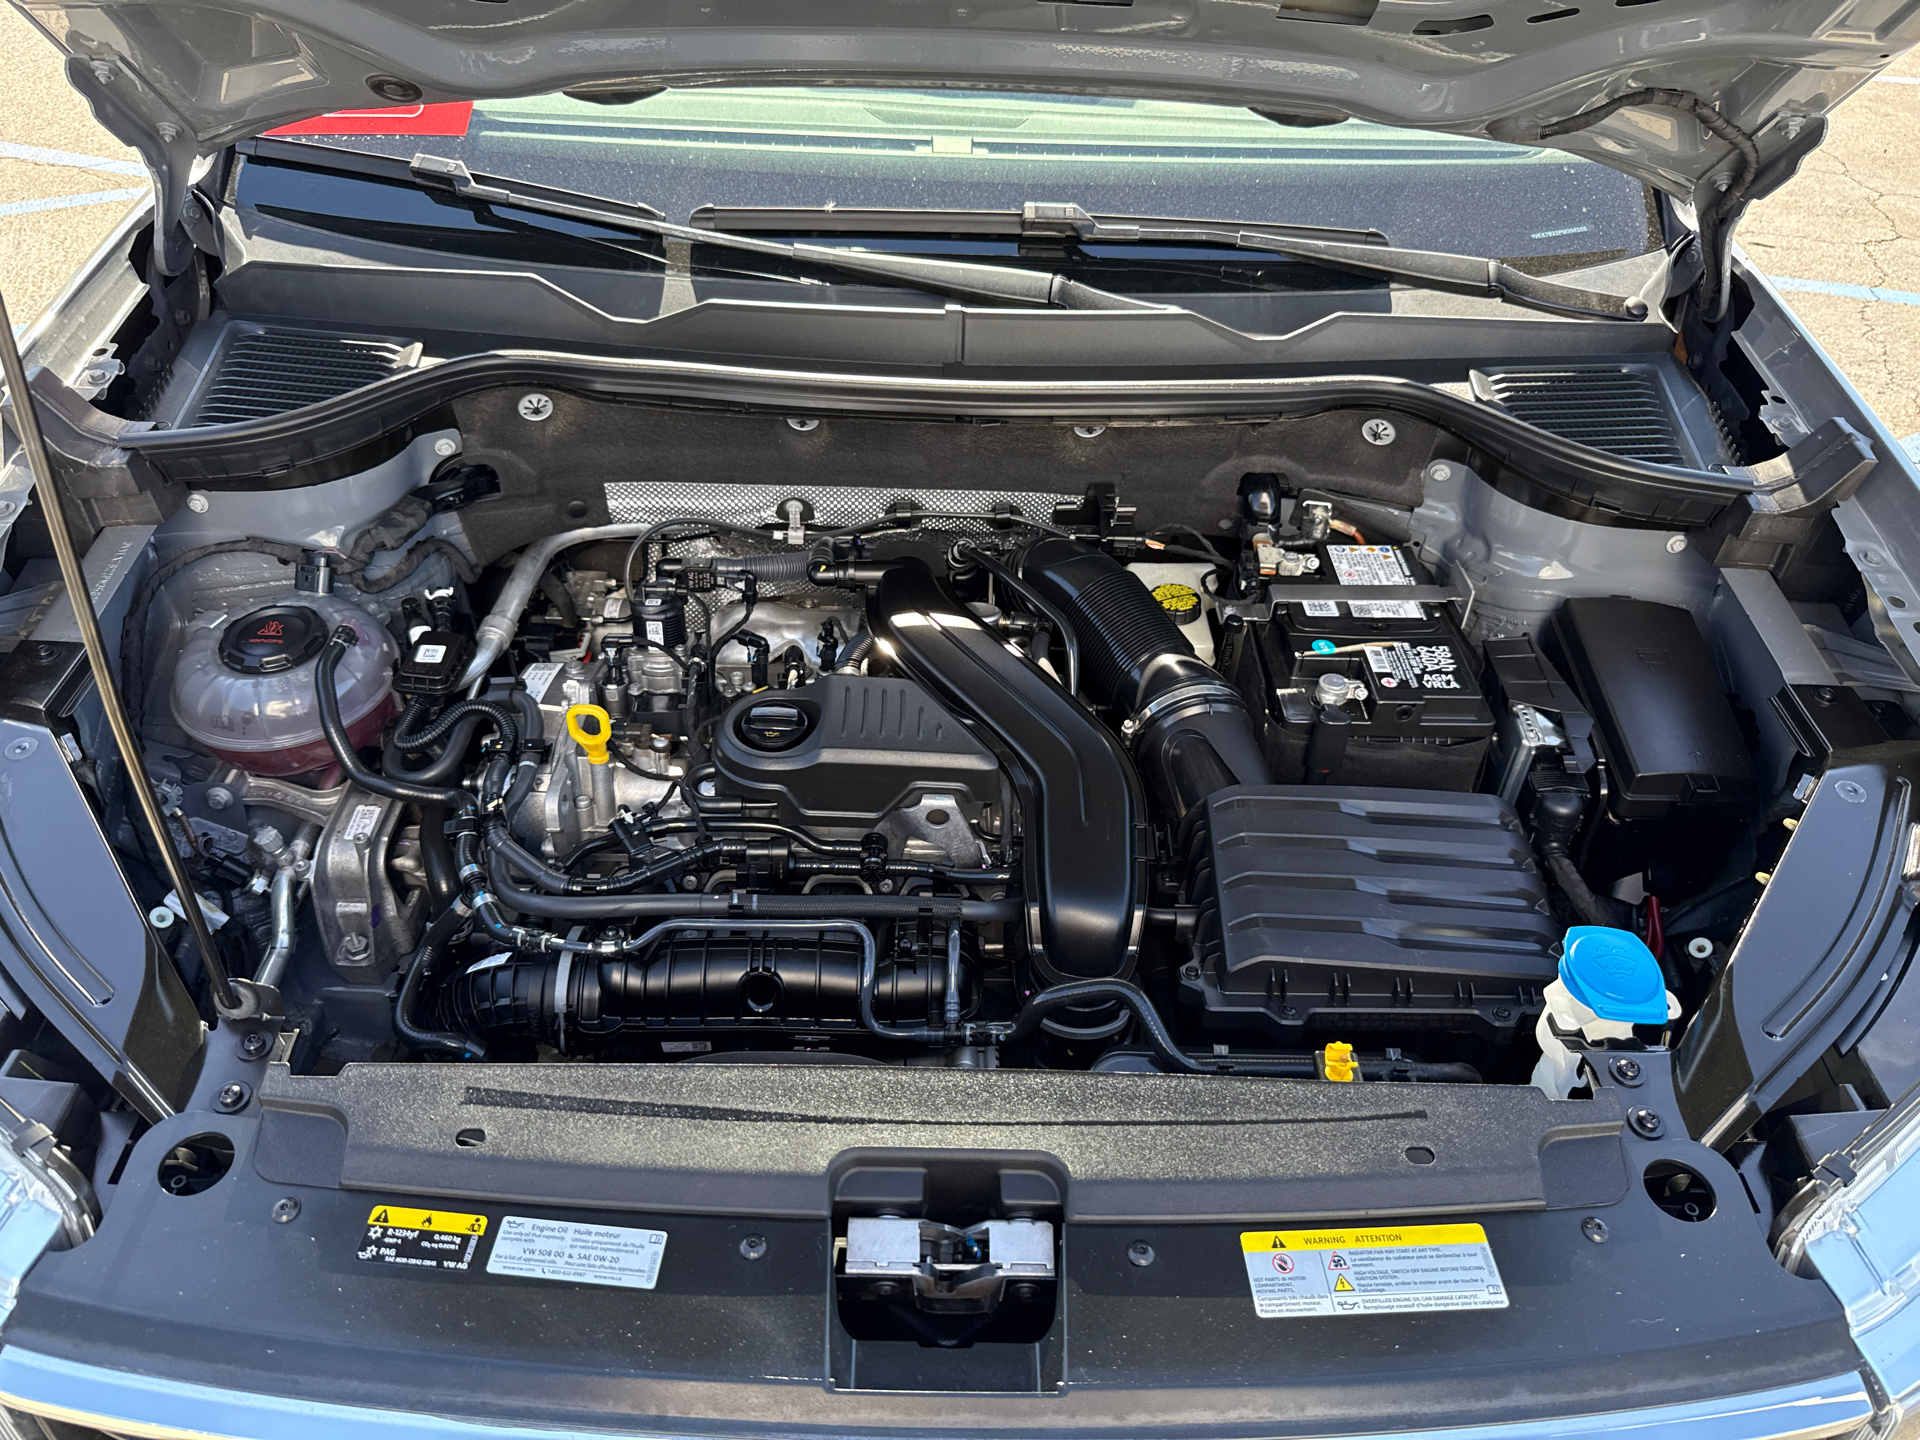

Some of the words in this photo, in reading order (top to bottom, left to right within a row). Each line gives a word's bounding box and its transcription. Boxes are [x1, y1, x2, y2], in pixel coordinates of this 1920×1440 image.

[1417, 645, 1441, 672] 640A
[1432, 645, 1457, 672] 58Ah
[1424, 674, 1454, 682] AGM
[1422, 681, 1461, 689] VRLA
[387, 1228, 420, 1240] R-1234yf
[453, 1236, 462, 1244] kg
[532, 1224, 556, 1233] Engine
[557, 1226, 568, 1234] Oil
[574, 1228, 593, 1236] Huile
[594, 1231, 621, 1239] moteur
[591, 1239, 622, 1248] uniquement
[1303, 1236, 1346, 1245] WARNING
[1355, 1234, 1402, 1243] ATTENTION
[380, 1248, 397, 1256] PAG
[523, 1247, 537, 1255] VW
[537, 1249, 553, 1257] 508
[577, 1253, 592, 1261] SAE
[593, 1255, 620, 1264] 0W-20
[457, 1262, 469, 1270] AG
